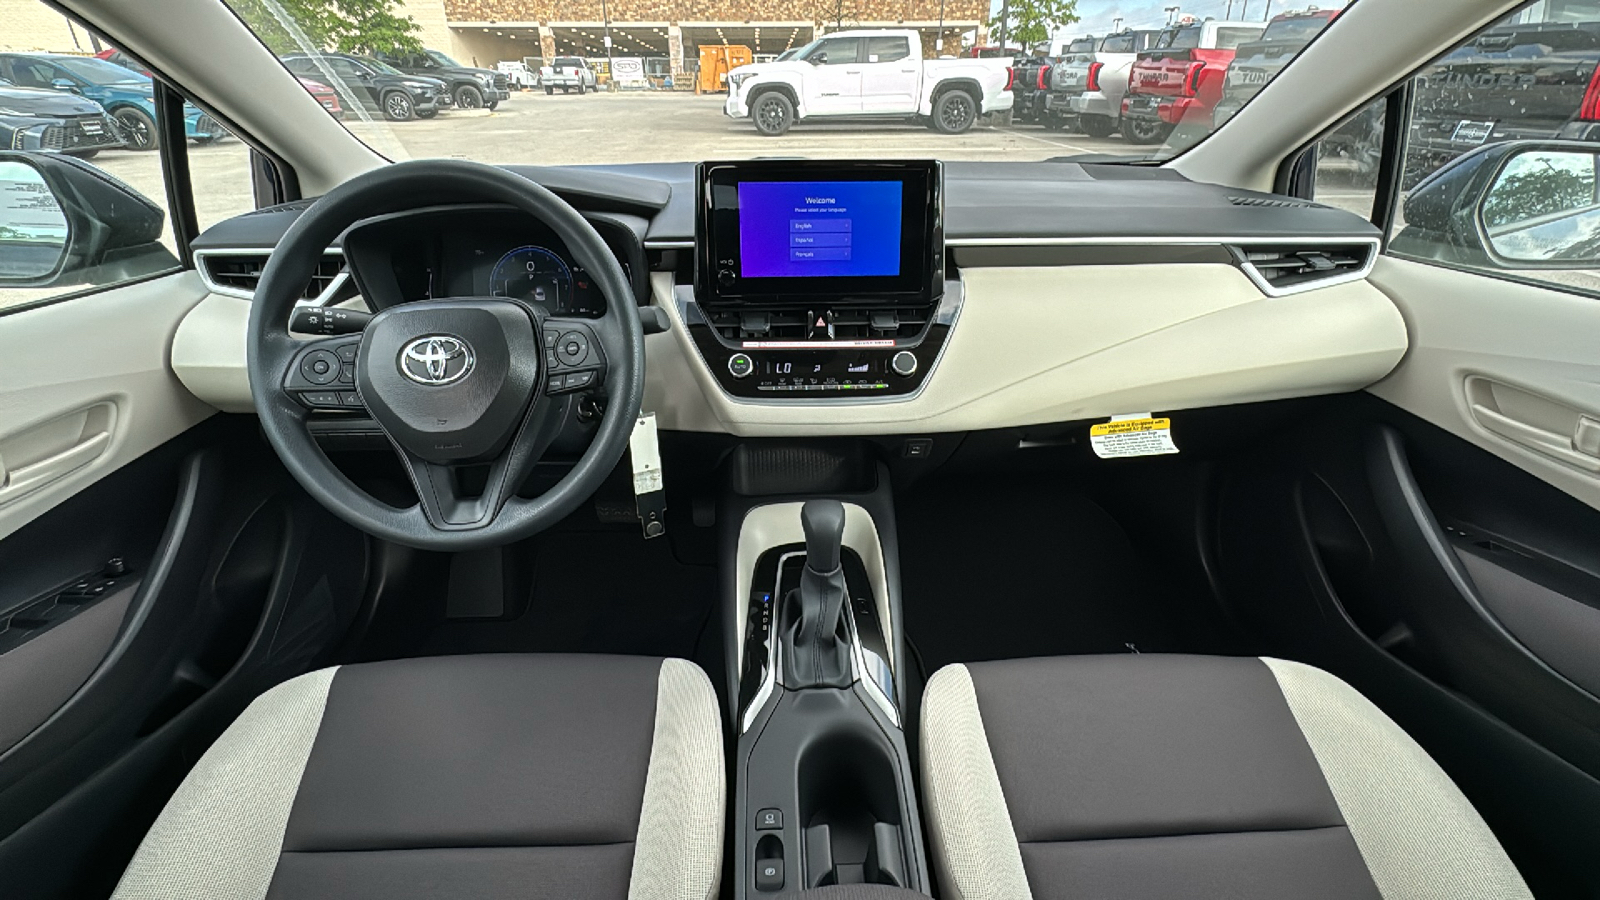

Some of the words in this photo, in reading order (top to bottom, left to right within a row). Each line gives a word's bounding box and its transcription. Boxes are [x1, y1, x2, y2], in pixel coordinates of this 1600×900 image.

[1138, 72, 1169, 81] TUNDRA
[1432, 73, 1536, 91] TUNDRA
[526, 261, 535, 272] 0
[1107, 422, 1126, 430] Vehicle
[1131, 420, 1154, 429] Equipped
[764, 594, 769, 602] P
